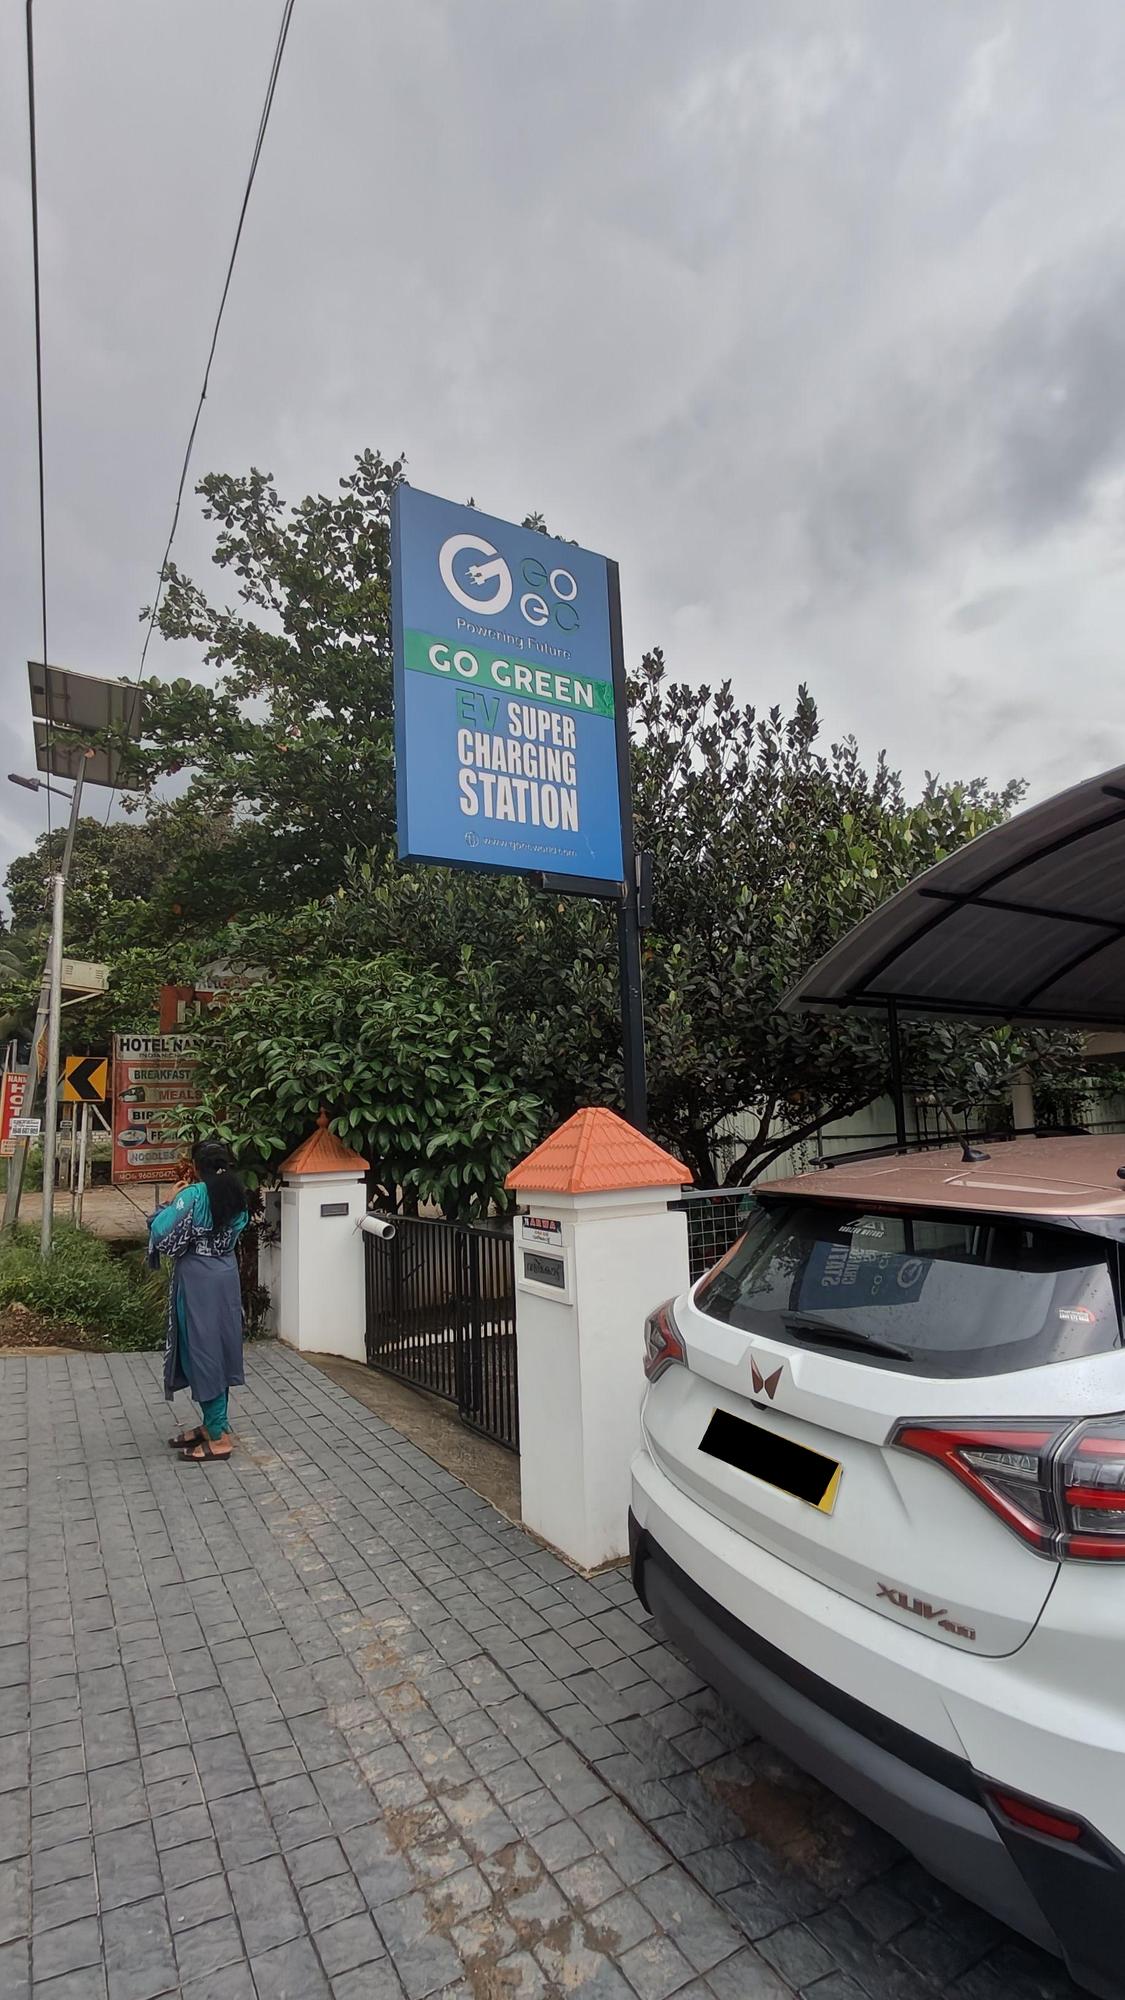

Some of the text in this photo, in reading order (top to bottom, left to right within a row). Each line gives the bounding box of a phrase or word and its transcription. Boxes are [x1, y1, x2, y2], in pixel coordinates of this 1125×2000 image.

[456, 617, 572, 660] Powering Future
[428, 643, 594, 709] GO GREEN
[455, 688, 576, 750] EV SUPER
[457, 728, 577, 786] CHARGING
[458, 768, 579, 833] STATION
[120, 1038, 169, 1052] HOTEL
[134, 1069, 191, 1080] BREAKFAST
[160, 1089, 202, 1100] MEALS
[131, 1151, 175, 1162] NOODLES
